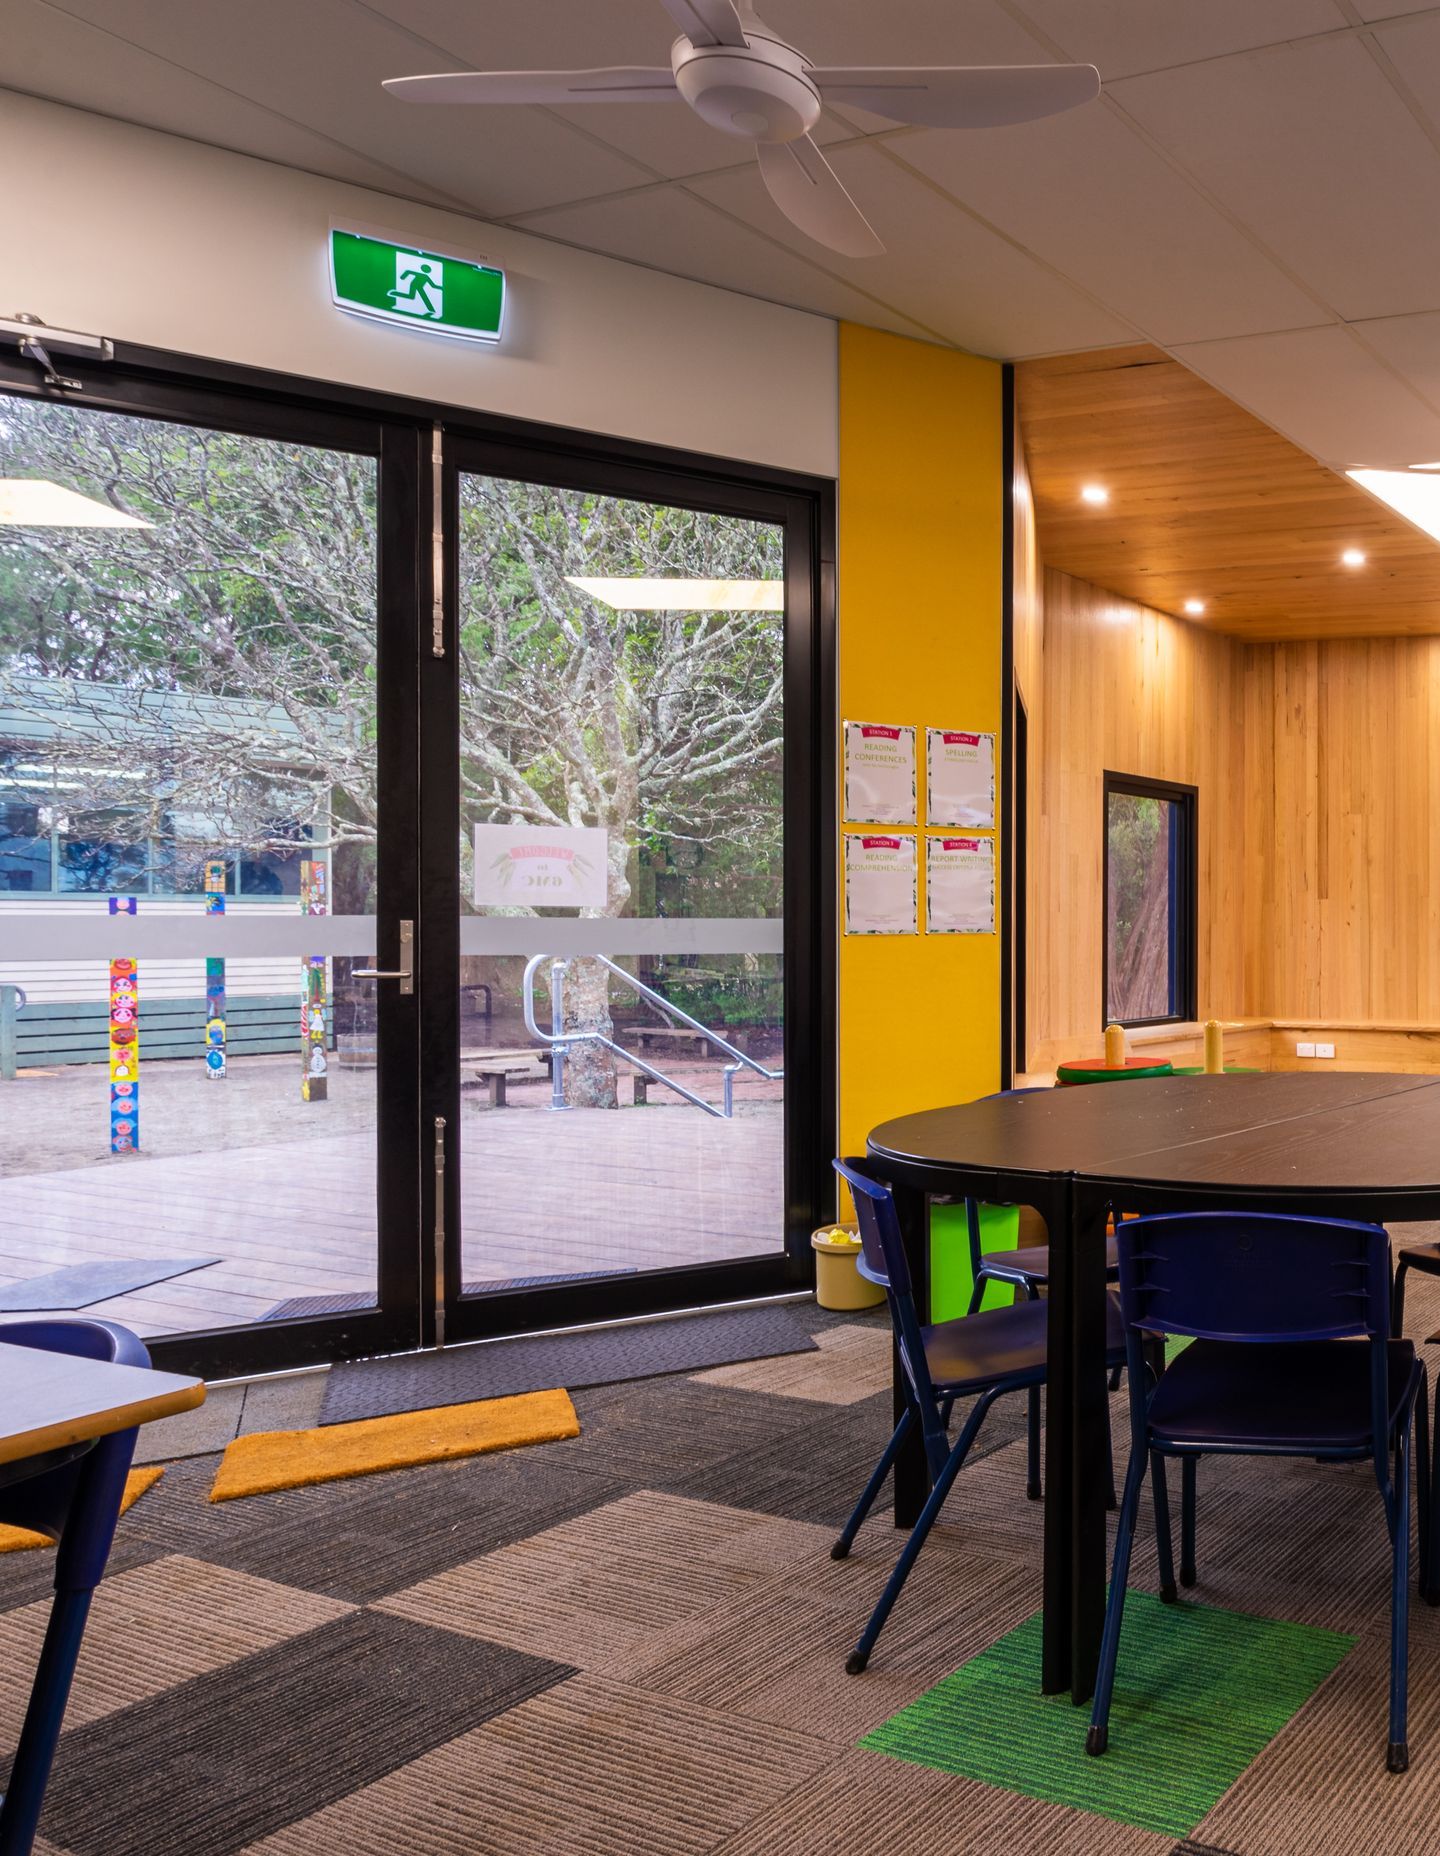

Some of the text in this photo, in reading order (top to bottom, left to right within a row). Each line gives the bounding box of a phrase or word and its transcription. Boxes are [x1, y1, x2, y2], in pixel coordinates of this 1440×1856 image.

[864, 743, 898, 752] READING
[945, 749, 977, 758] SPELLING
[854, 753, 907, 764] CONFERENCES
[865, 853, 898, 862] READING
[931, 855, 958, 863] REPORT
